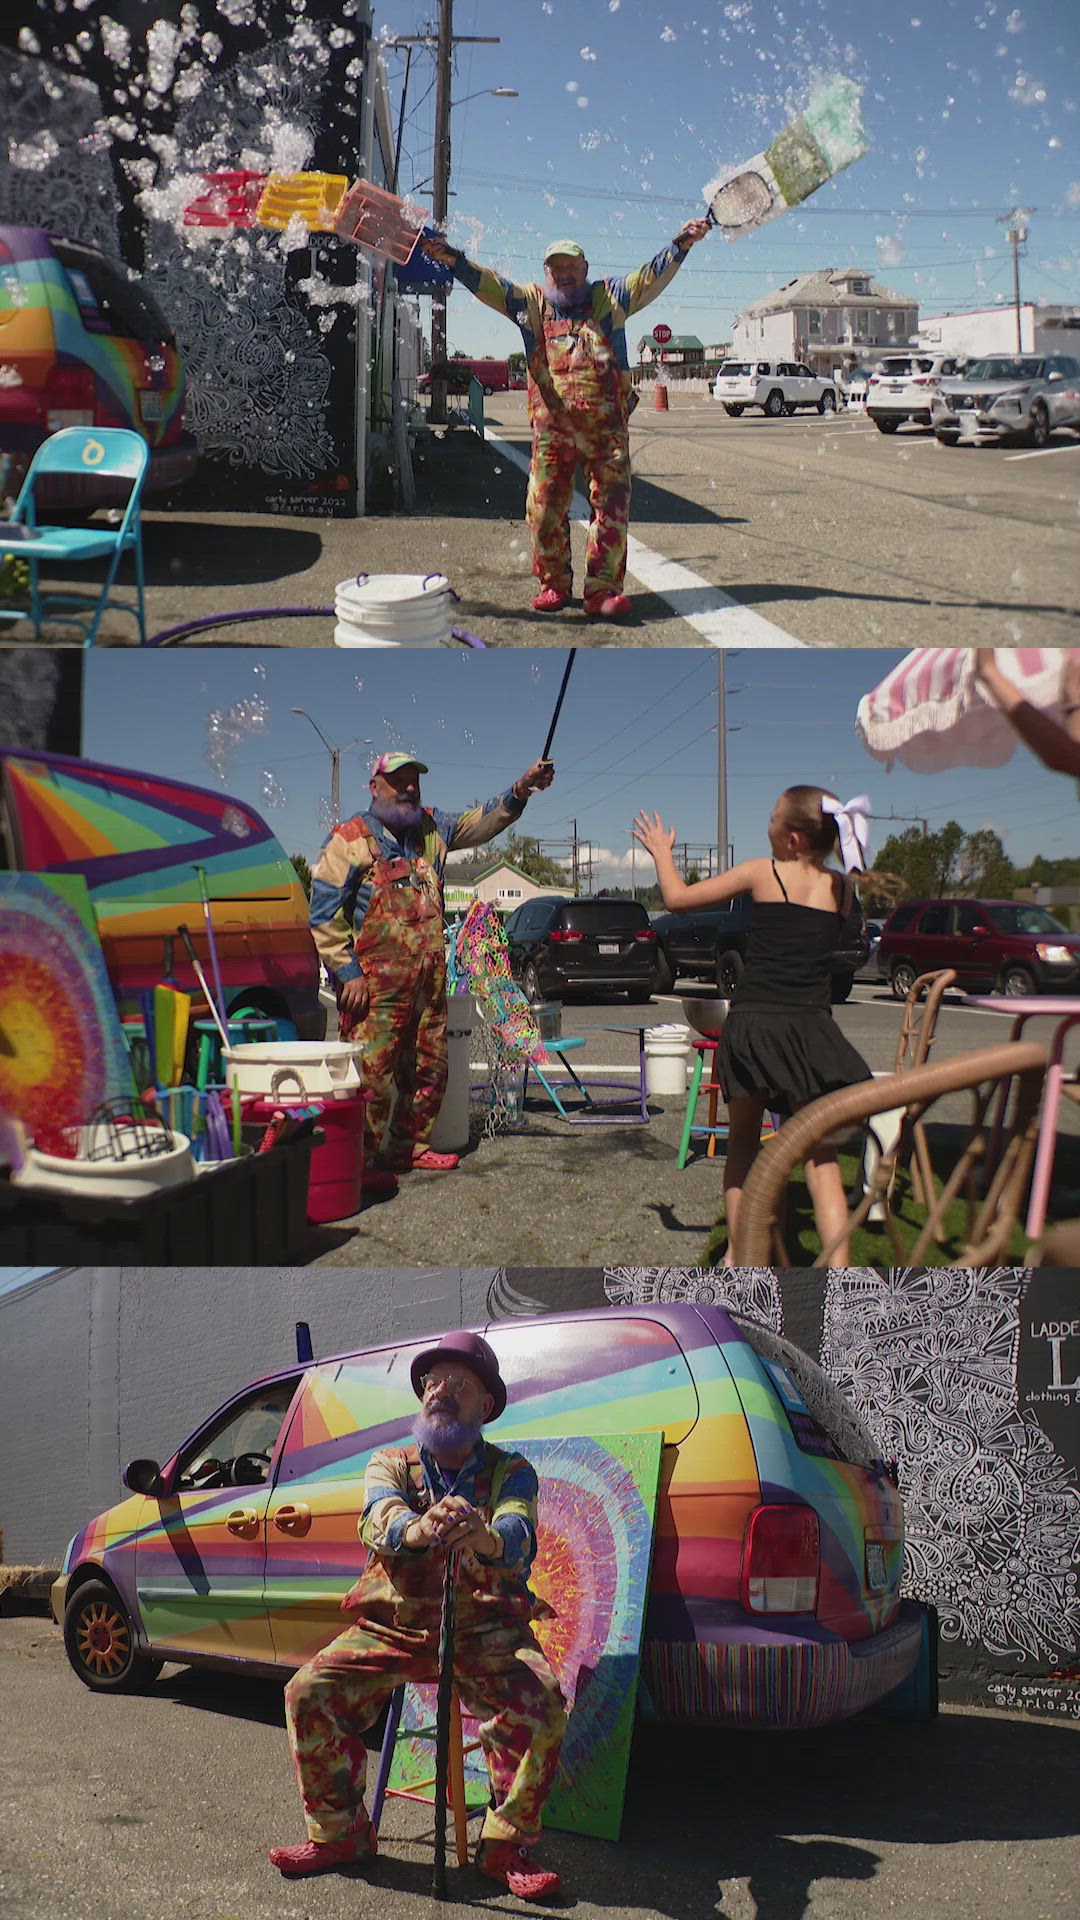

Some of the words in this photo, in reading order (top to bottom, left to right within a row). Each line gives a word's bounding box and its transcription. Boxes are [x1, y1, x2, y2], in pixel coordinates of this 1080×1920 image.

[654, 330, 671, 339] STOP
[289, 496, 319, 504] sarver
[322, 497, 346, 506] 2022
[1025, 1390, 1071, 1407] clothing
[987, 1683, 1017, 1699] carly
[1020, 1686, 1062, 1697] sarver
